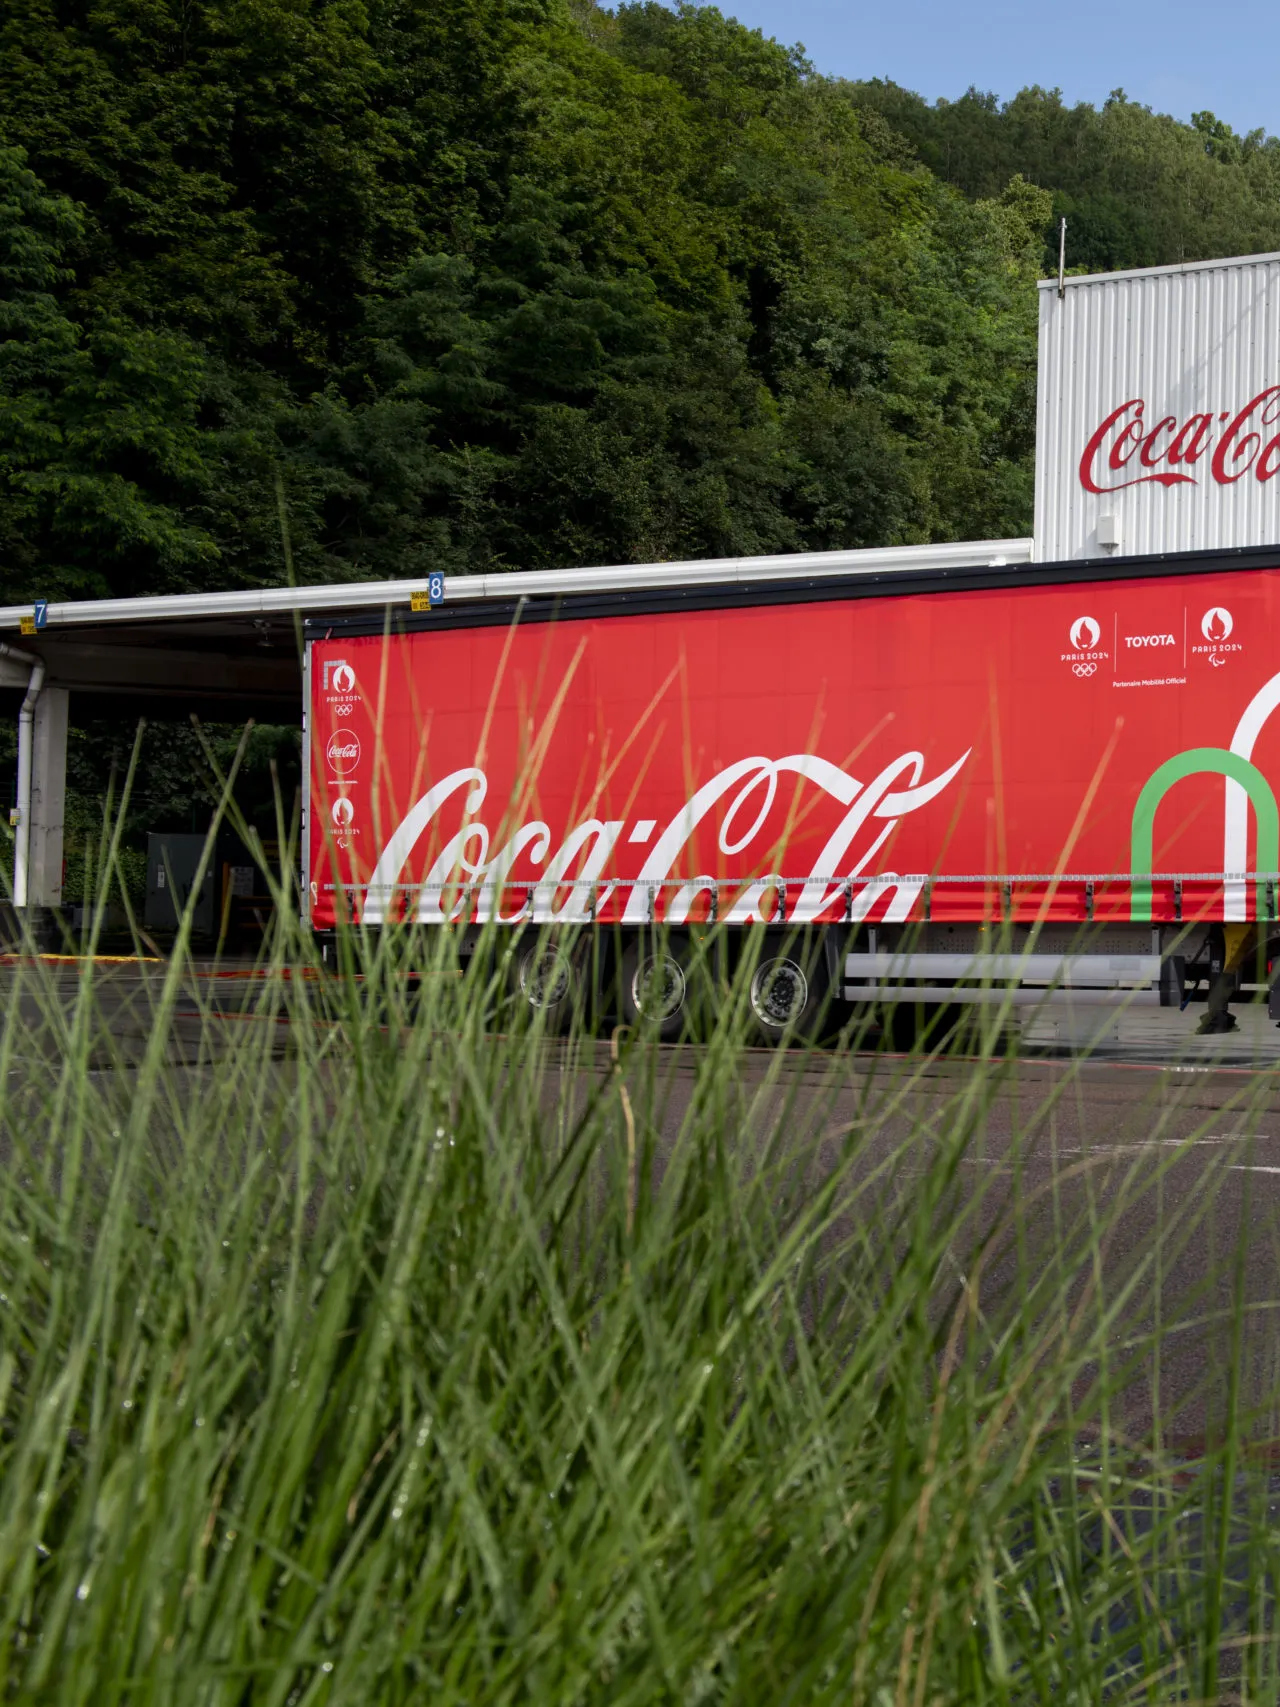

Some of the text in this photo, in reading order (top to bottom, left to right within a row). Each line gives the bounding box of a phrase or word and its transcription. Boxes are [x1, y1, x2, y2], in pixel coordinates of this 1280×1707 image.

[431, 578, 442, 599] 8
[36, 604, 46, 624] 7
[1125, 634, 1176, 648] TOYOTA
[1192, 643, 1243, 653] PARIS 2024
[1061, 652, 1109, 661] PARIS 2024
[328, 744, 359, 758] Coca-Cola
[328, 828, 343, 836] ARIS
